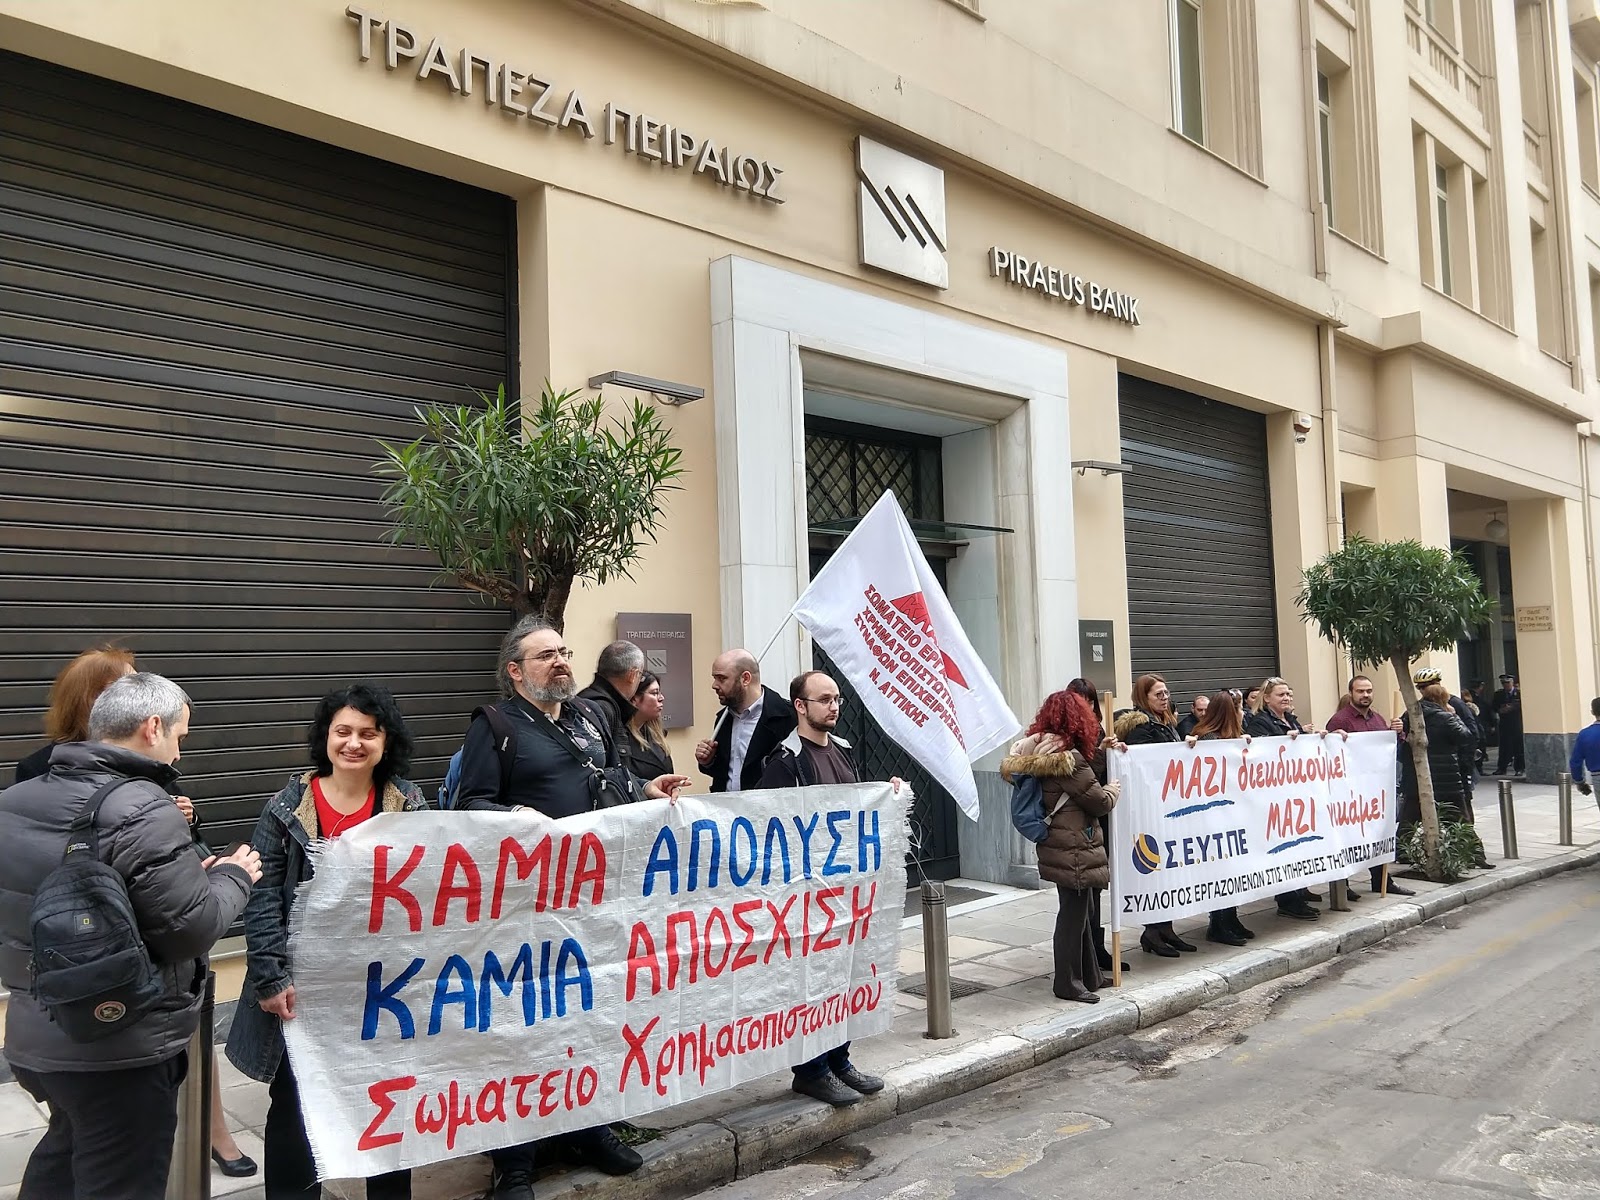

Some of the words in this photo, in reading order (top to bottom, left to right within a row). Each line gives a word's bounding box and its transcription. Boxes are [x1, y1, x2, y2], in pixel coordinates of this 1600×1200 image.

[345, 4, 595, 140] ΤΡΑΠΕΖΑ
[603, 101, 786, 204] ΠΕΙΡΑΙΩΣ
[989, 246, 1085, 306] PIRAEUS
[1086, 281, 1141, 326] BANK
[626, 631, 656, 639] ΤΡΑΠΕΖΑ
[854, 613, 899, 673] ΣΥΝΑΦΩΝ
[864, 584, 922, 648] ΣΩΜΑΤΕΙΟ
[868, 667, 881, 685] Ν.
[878, 681, 930, 728] ΑΤΤΙΚΗΣ
[1161, 755, 1227, 802] ΜΑΖΙ
[1237, 745, 1346, 795] διεκδικούμε!
[1266, 796, 1315, 841] ΜΑΖΙ
[1327, 789, 1386, 838] νικάμε!
[367, 832, 606, 934] ΚΑΜΙΑ
[643, 809, 882, 897] ΑΠΟΛΥΣΗ
[1123, 886, 1192, 913] ΣΥΛΛΟΓΟΣ
[1194, 870, 1265, 902] ΕΡΓΑΖΟΜΕΝΩΝ
[1265, 867, 1282, 885] ΣΤΙΣ
[1282, 856, 1327, 880] ΥΠΗΡΕΣΙΕΣ
[1327, 853, 1345, 870] ΤΗΣ
[361, 937, 593, 1040] ΚΑΜΙΑ
[625, 881, 876, 1002] ΑΠΟΣΧΙΣΗ
[357, 1047, 598, 1151] Σωματείο
[619, 963, 882, 1097] Χρηματοπιστωτικού
